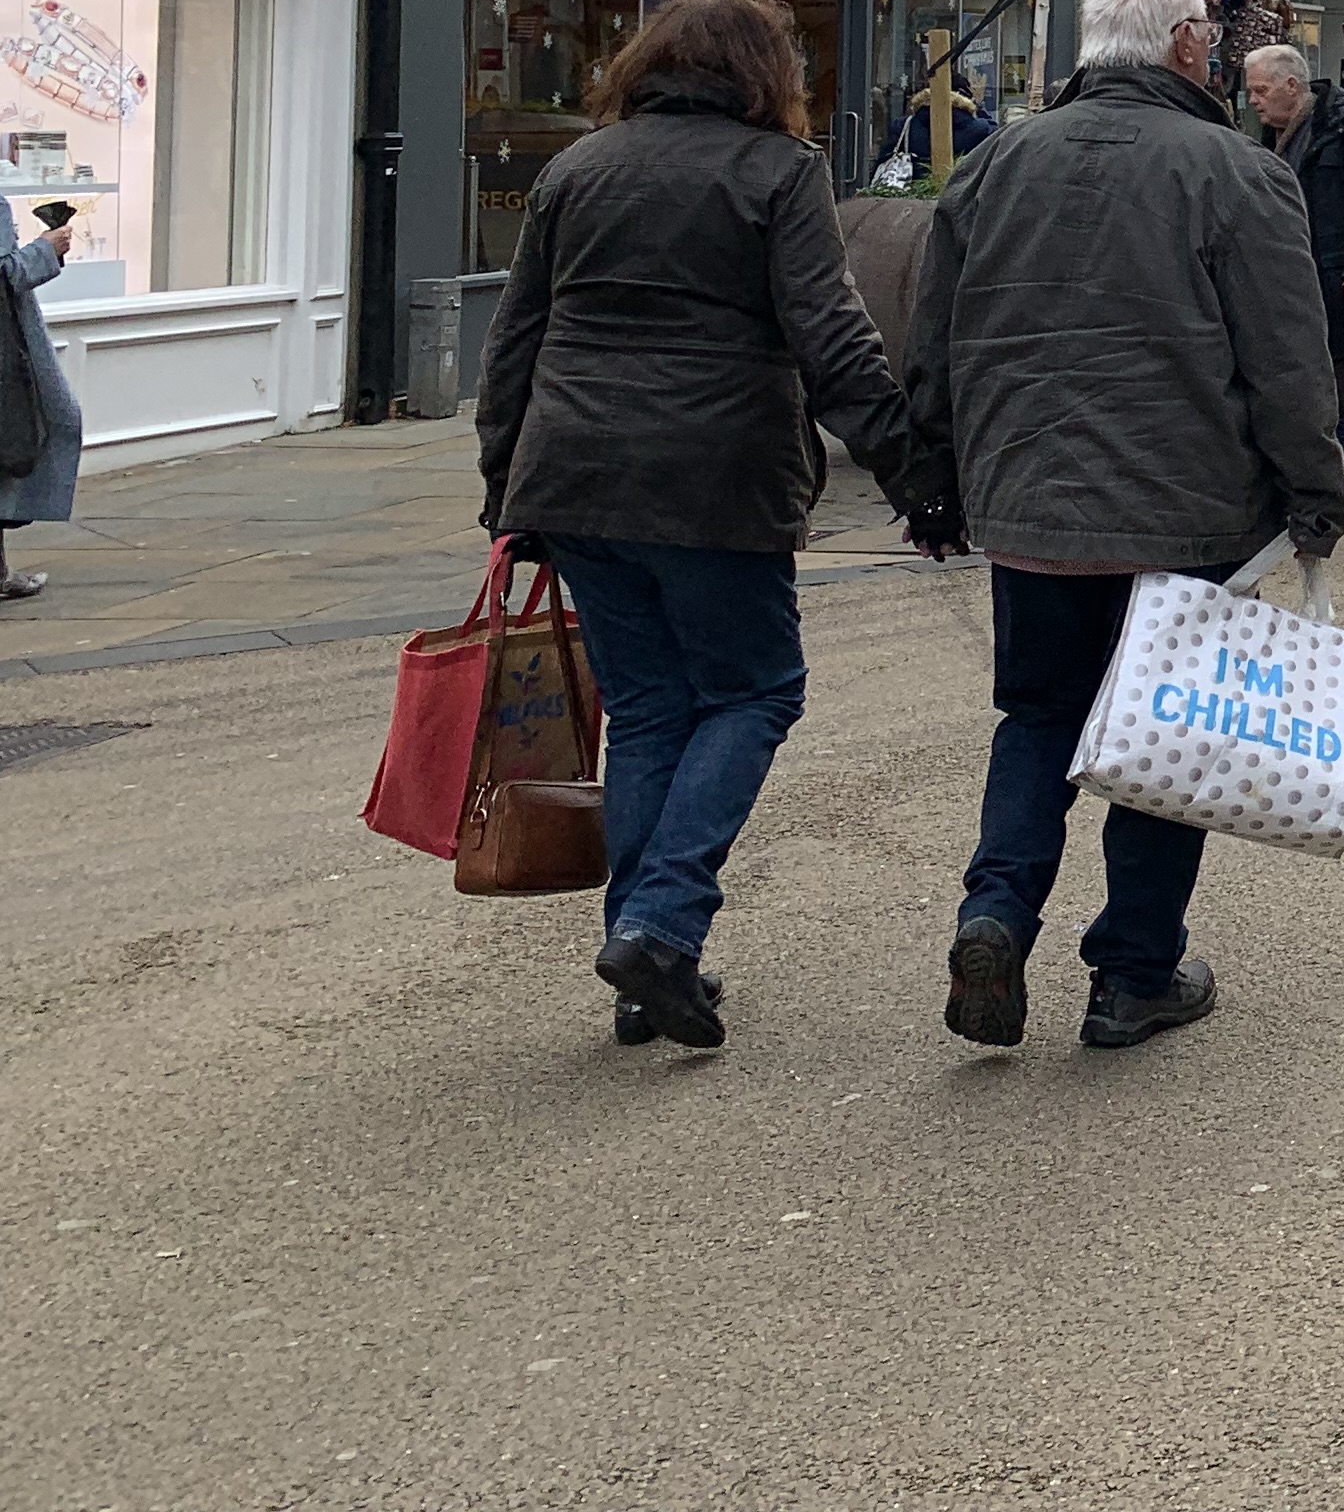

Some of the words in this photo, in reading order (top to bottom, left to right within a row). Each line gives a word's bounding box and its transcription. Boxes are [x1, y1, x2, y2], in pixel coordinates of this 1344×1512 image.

[478, 191, 529, 210] REG
[1215, 648, 1284, 698] I'M
[1152, 683, 1342, 763] CHILLED
